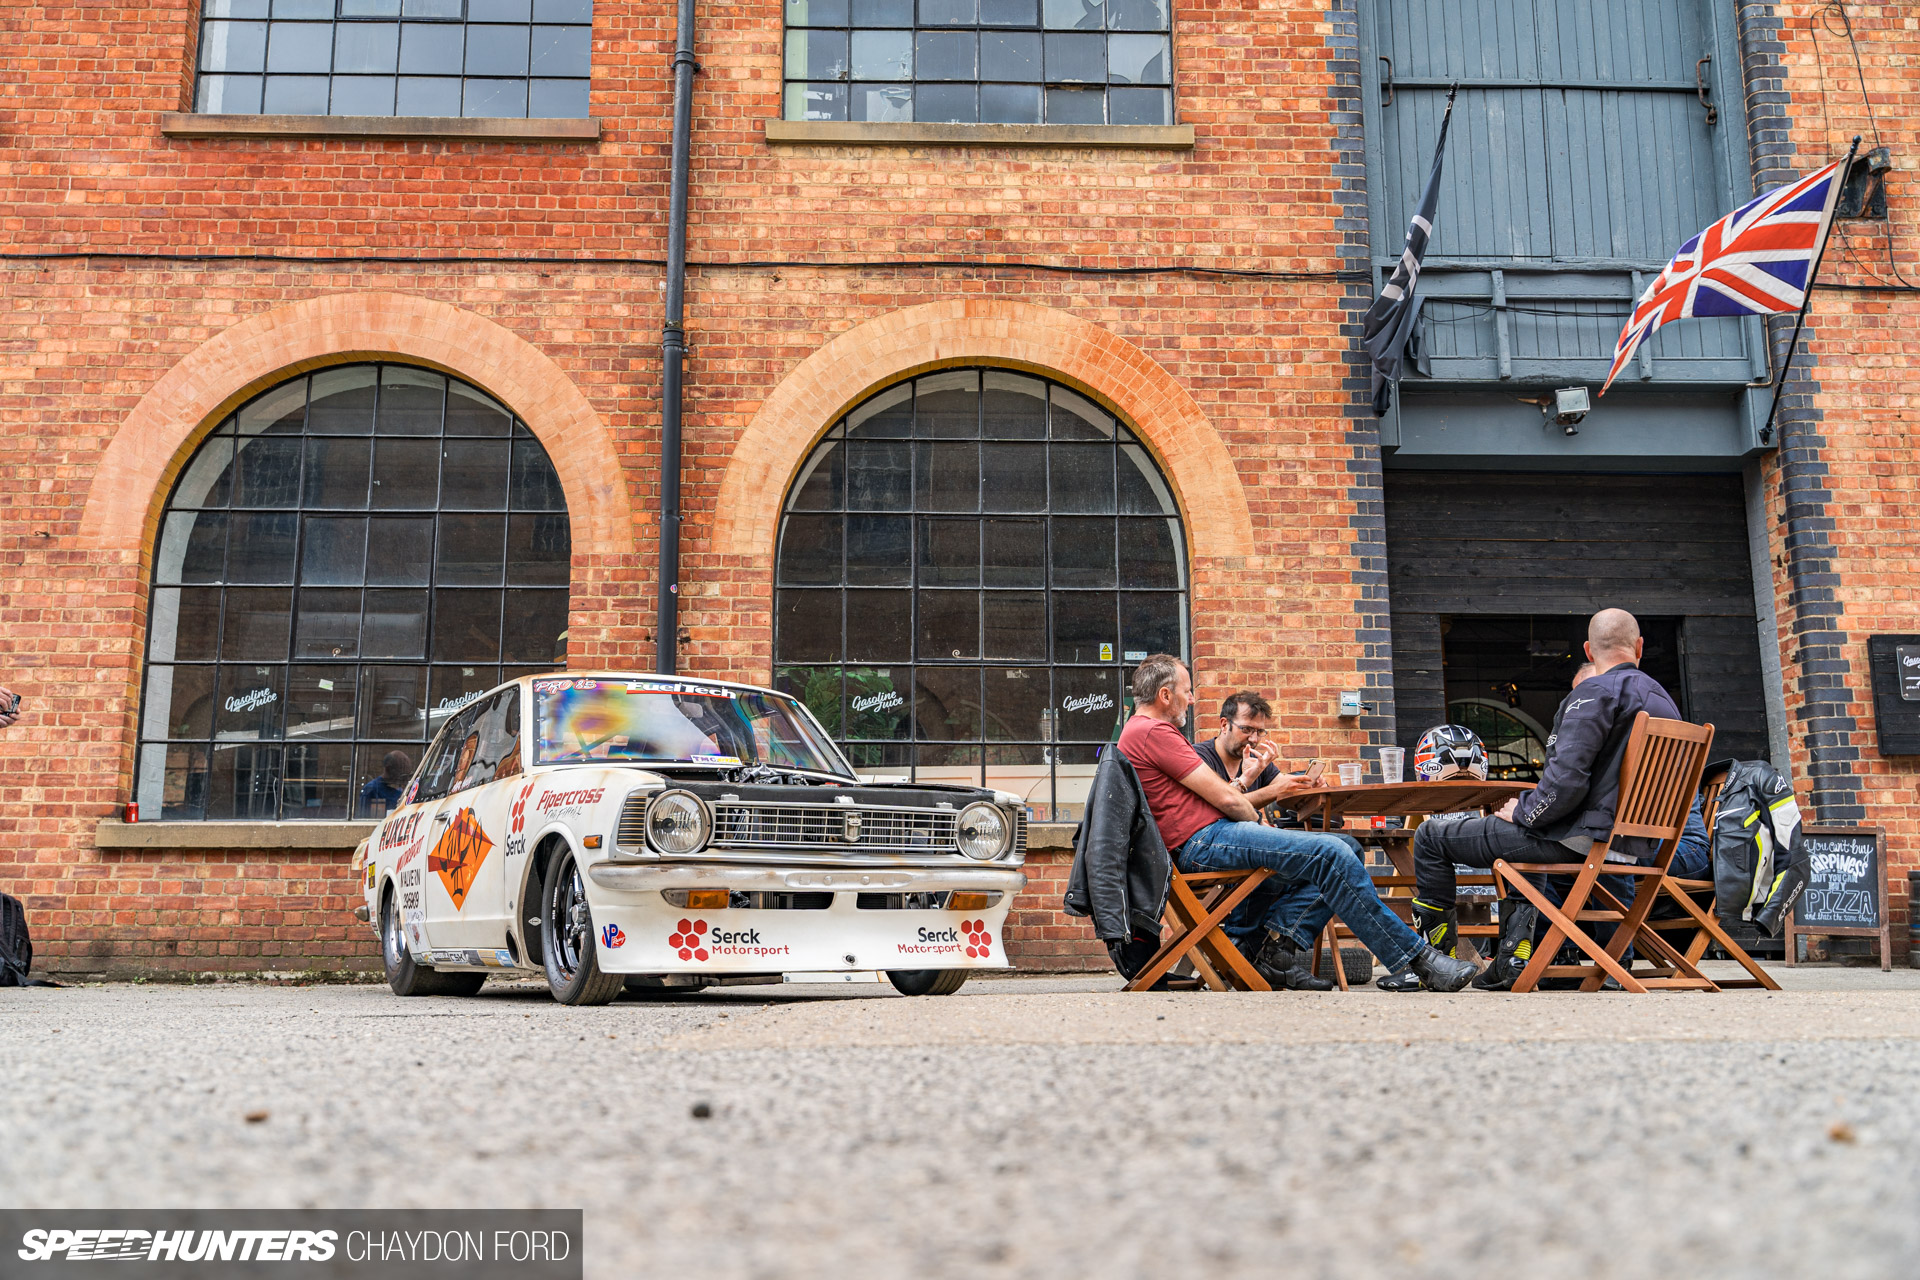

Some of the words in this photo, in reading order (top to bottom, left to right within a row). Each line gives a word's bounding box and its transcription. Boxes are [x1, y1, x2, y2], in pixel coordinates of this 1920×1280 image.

[624, 681, 736, 699] FuelTech
[225, 687, 270, 712] Gasoline
[247, 692, 278, 712] Juice
[852, 690, 897, 711] Gasoline
[874, 696, 904, 713] Juice
[1062, 693, 1108, 711] Gasoline
[1083, 699, 1114, 714] Juice
[1424, 763, 1440, 772] Arai
[536, 787, 606, 815] Pipercross
[379, 811, 425, 852] HUXLEY
[506, 833, 526, 857] Serck
[1803, 838, 1829, 855] You
[1850, 838, 1874, 863] buy
[1810, 871, 1827, 883] BUT
[1804, 889, 1873, 915] PIZZA
[602, 923, 619, 949] VP
[711, 927, 761, 944] Serck
[917, 926, 959, 943] Serck
[711, 944, 790, 958] Motorsport
[897, 943, 963, 955] Motorsport
